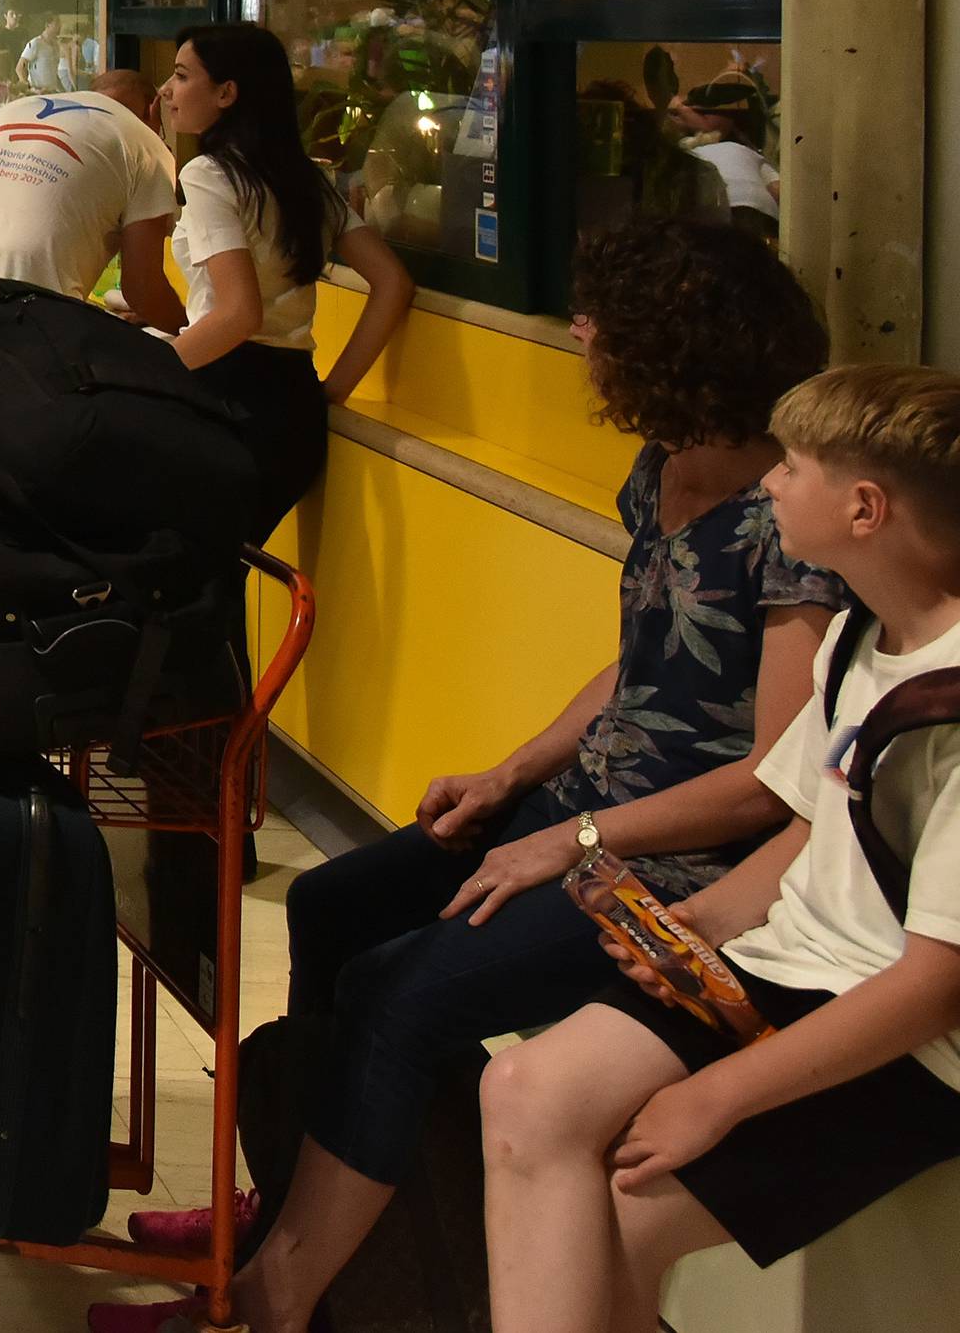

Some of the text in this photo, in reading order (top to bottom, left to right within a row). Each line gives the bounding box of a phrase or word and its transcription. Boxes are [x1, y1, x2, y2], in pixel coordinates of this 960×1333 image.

[0, 148, 25, 159] World
[27, 153, 70, 178] Precision
[20, 173, 43, 186] 2017
